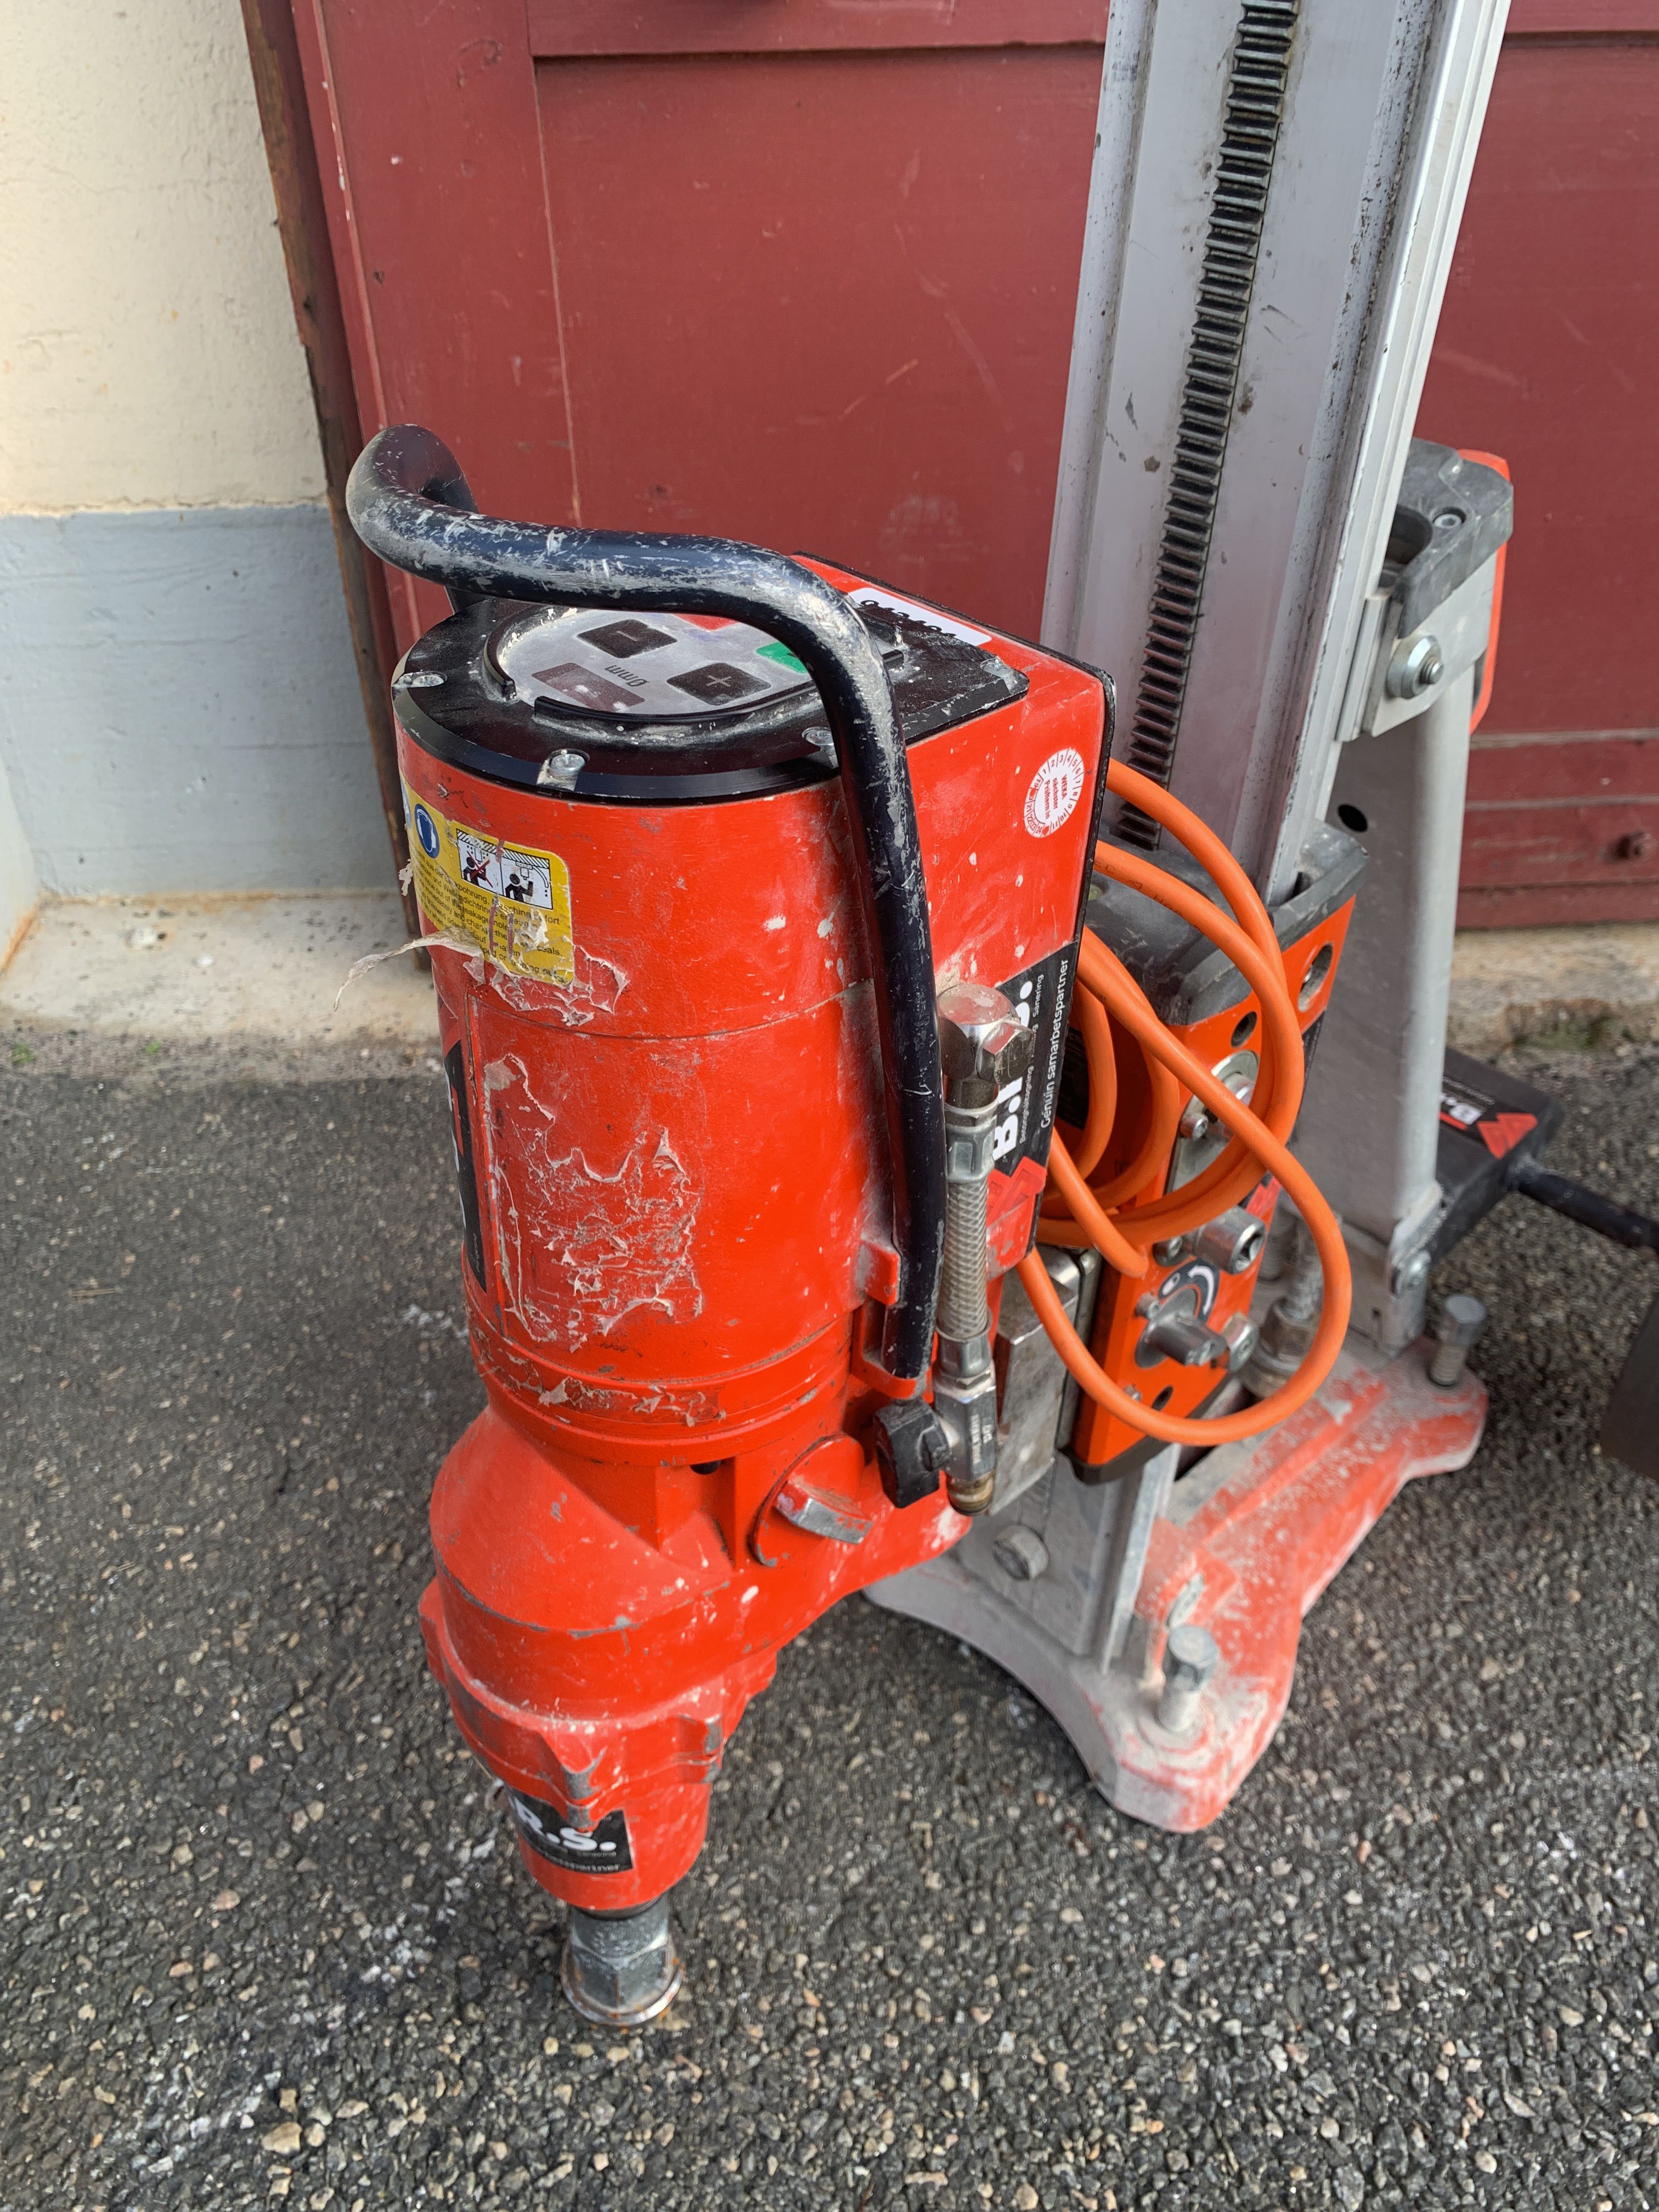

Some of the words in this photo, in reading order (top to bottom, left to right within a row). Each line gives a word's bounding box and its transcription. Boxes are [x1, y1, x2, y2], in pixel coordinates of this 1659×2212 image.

[1059, 755, 1064, 763] 3
[1034, 779, 1041, 788] 19
[1060, 812, 1066, 821] 10
[1052, 819, 1059, 830] 11
[454, 911, 465, 922] and
[1032, 974, 1045, 1019] Sanering
[1047, 959, 1069, 1081] samarbetspartner
